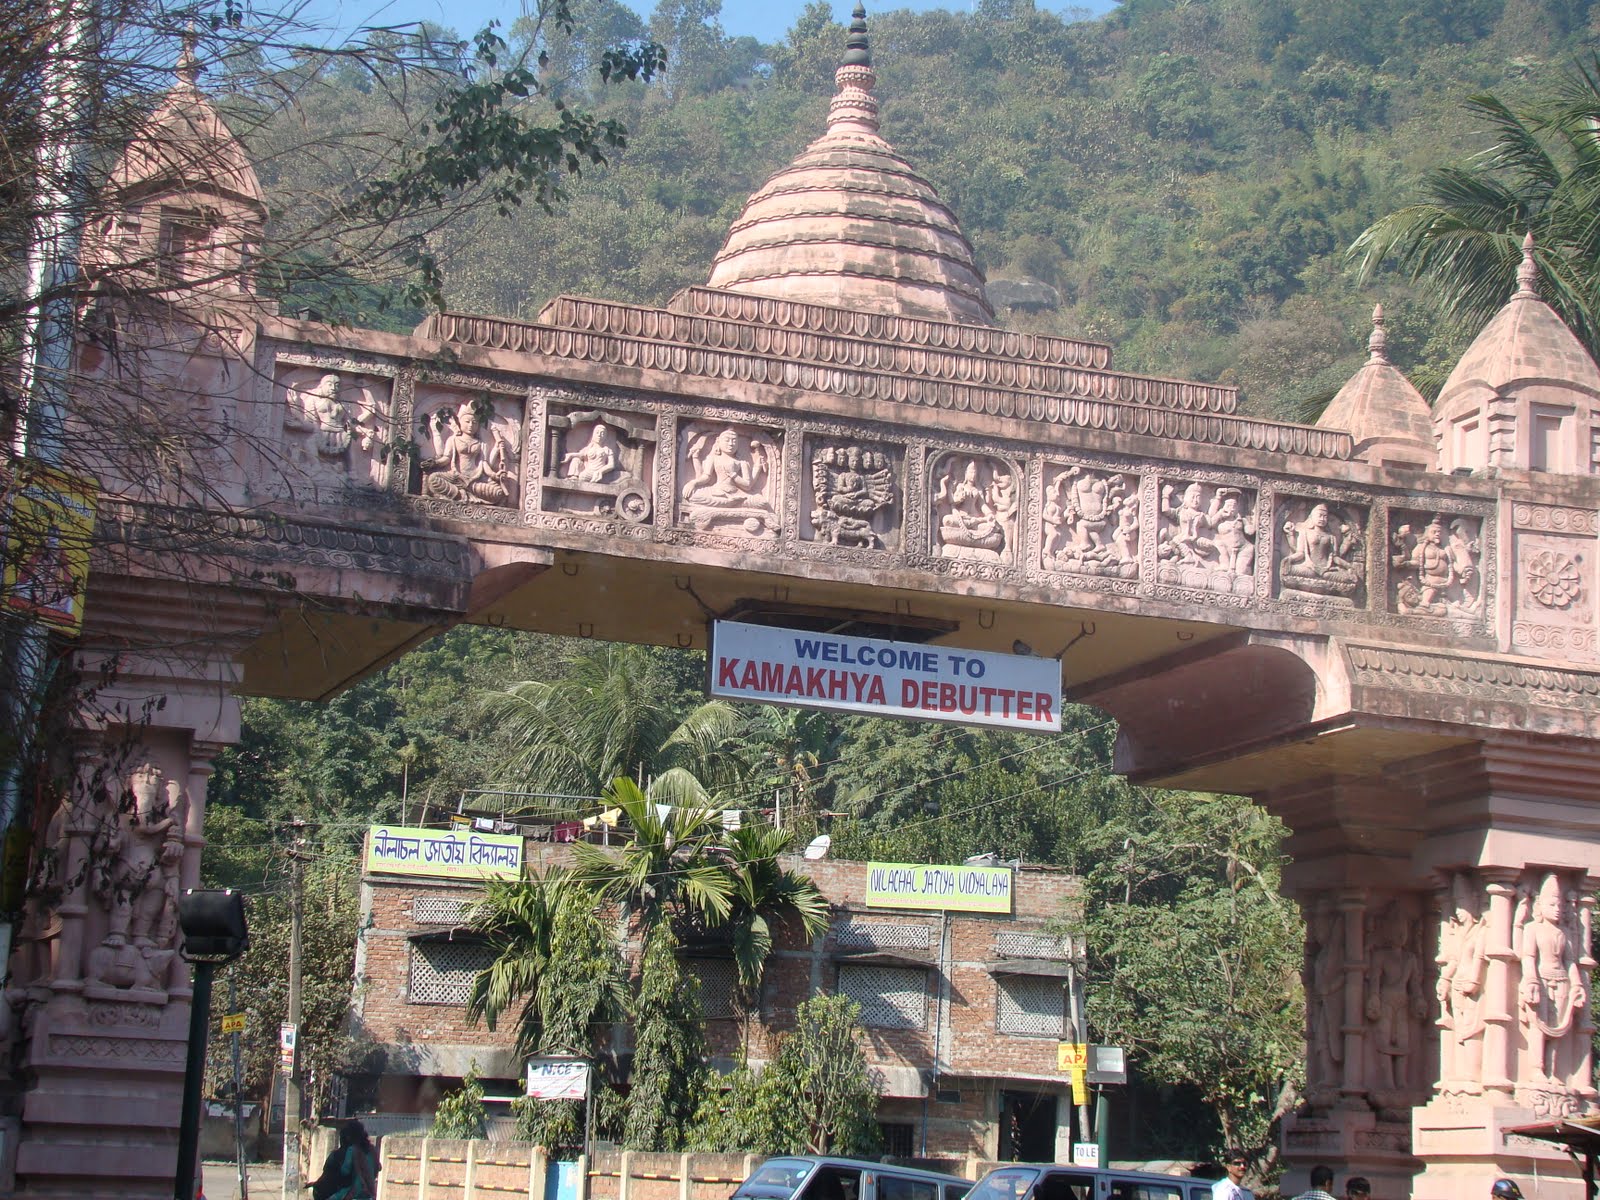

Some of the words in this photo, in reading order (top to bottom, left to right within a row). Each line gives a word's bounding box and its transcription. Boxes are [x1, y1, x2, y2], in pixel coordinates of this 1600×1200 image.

[794, 638, 939, 673] WELCOME
[948, 656, 986, 679] TO
[718, 656, 887, 705] KAMAKHYA
[902, 678, 1053, 723] DEBUTTER
[374, 829, 420, 859] নীলাচল
[470, 836, 518, 868] বিদ্যালয়
[1086, 1147, 1099, 1158] LE
